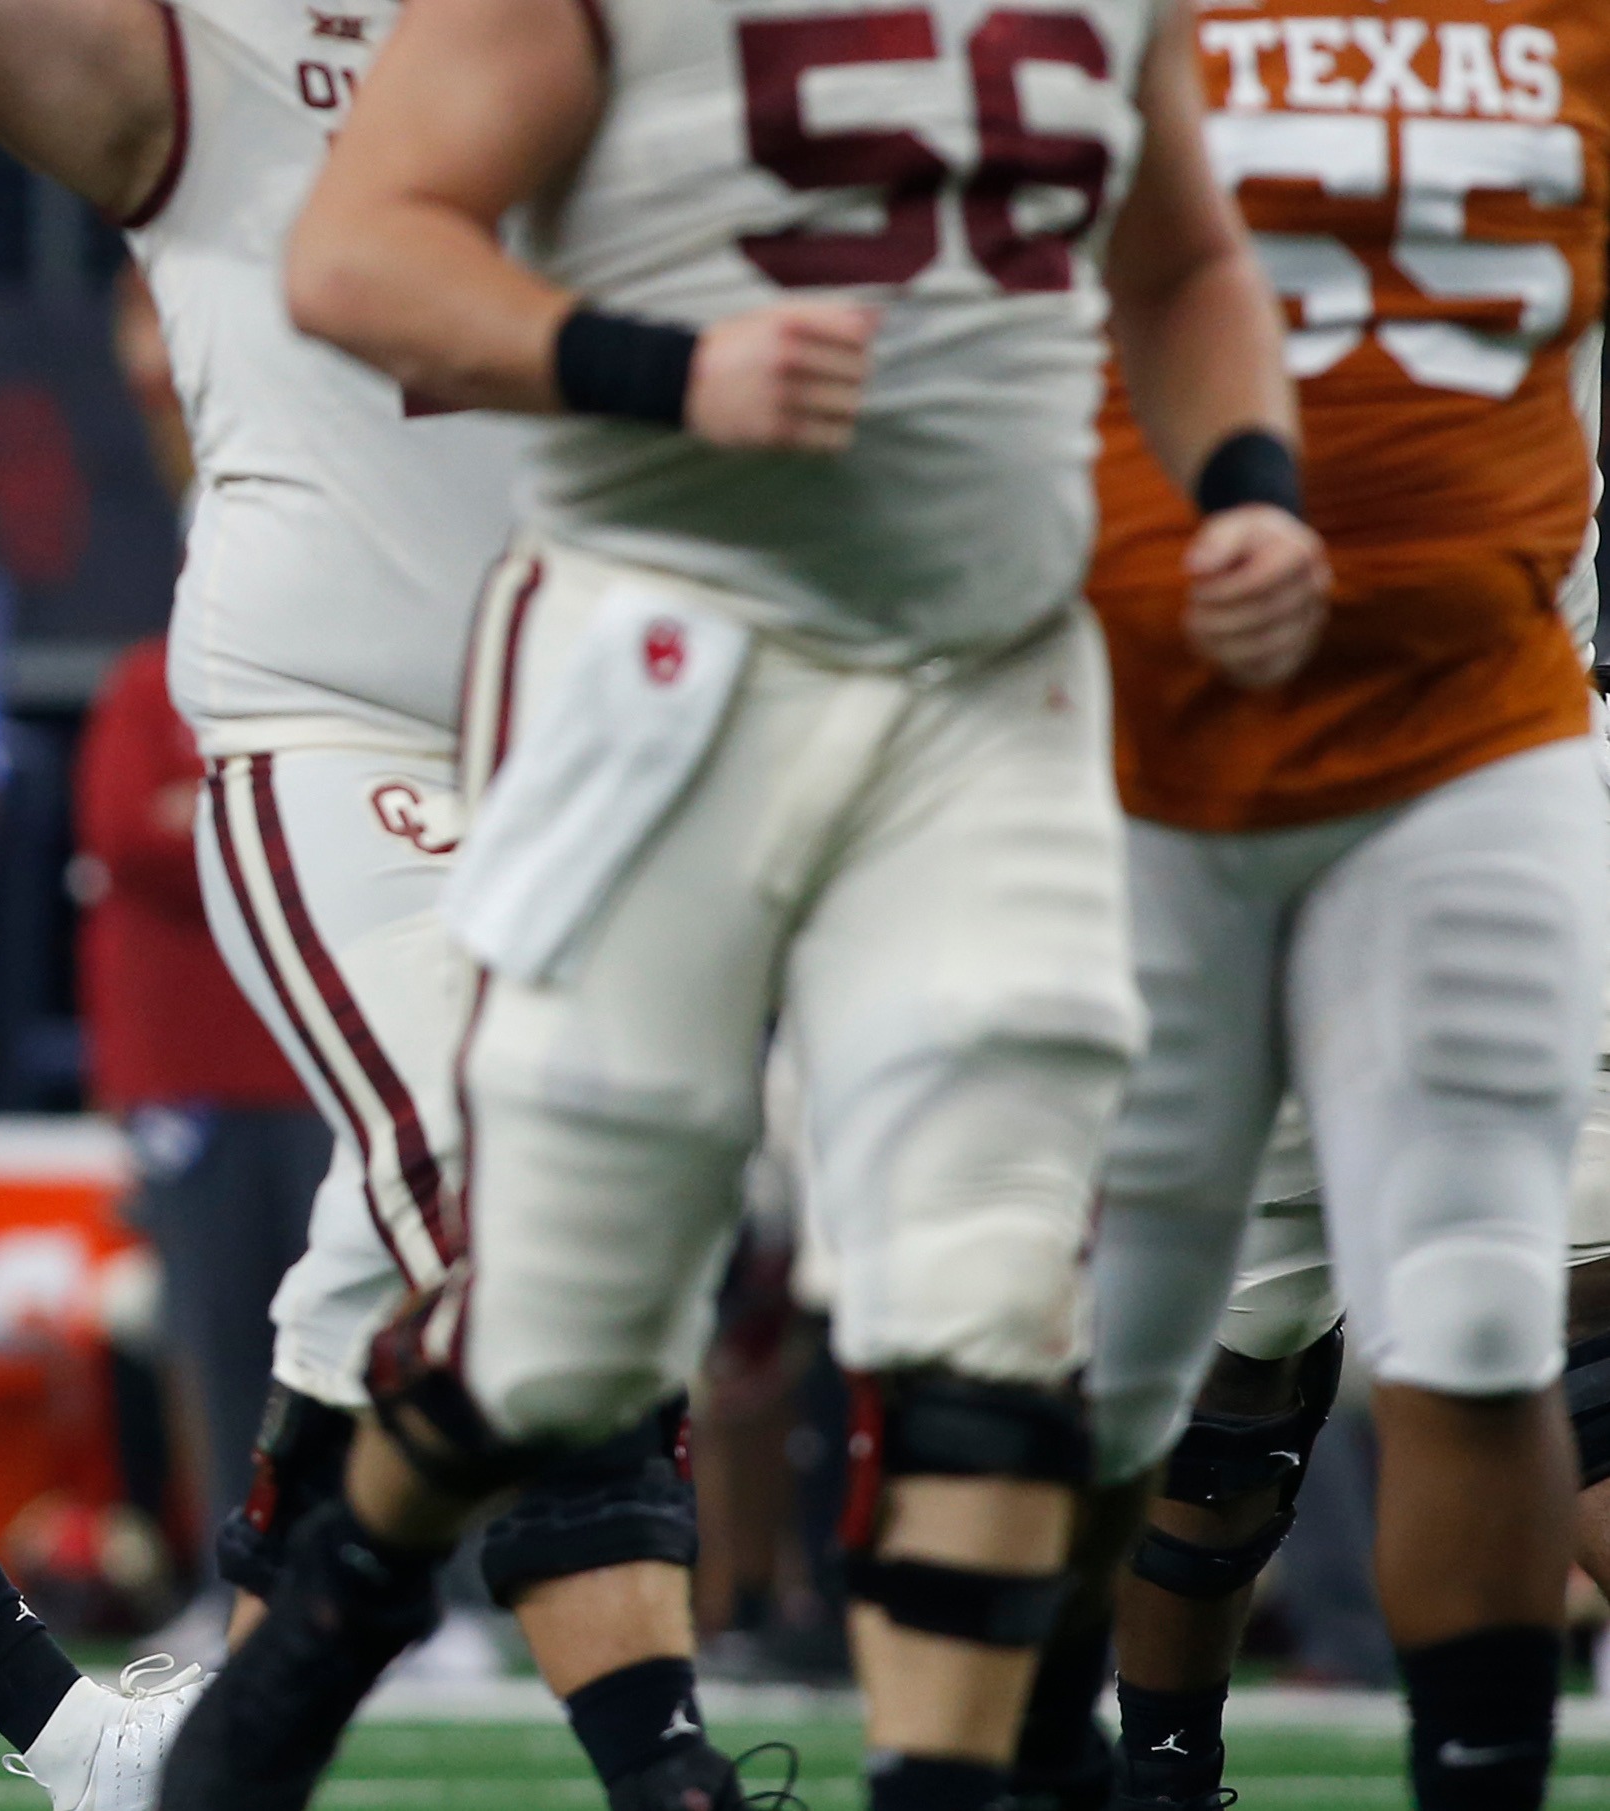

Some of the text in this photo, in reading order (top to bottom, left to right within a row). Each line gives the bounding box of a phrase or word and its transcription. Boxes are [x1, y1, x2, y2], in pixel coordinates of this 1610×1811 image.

[737, 9, 1112, 293] 56
[1198, 15, 1561, 119] TEXAS
[1203, 112, 1586, 399] 55
